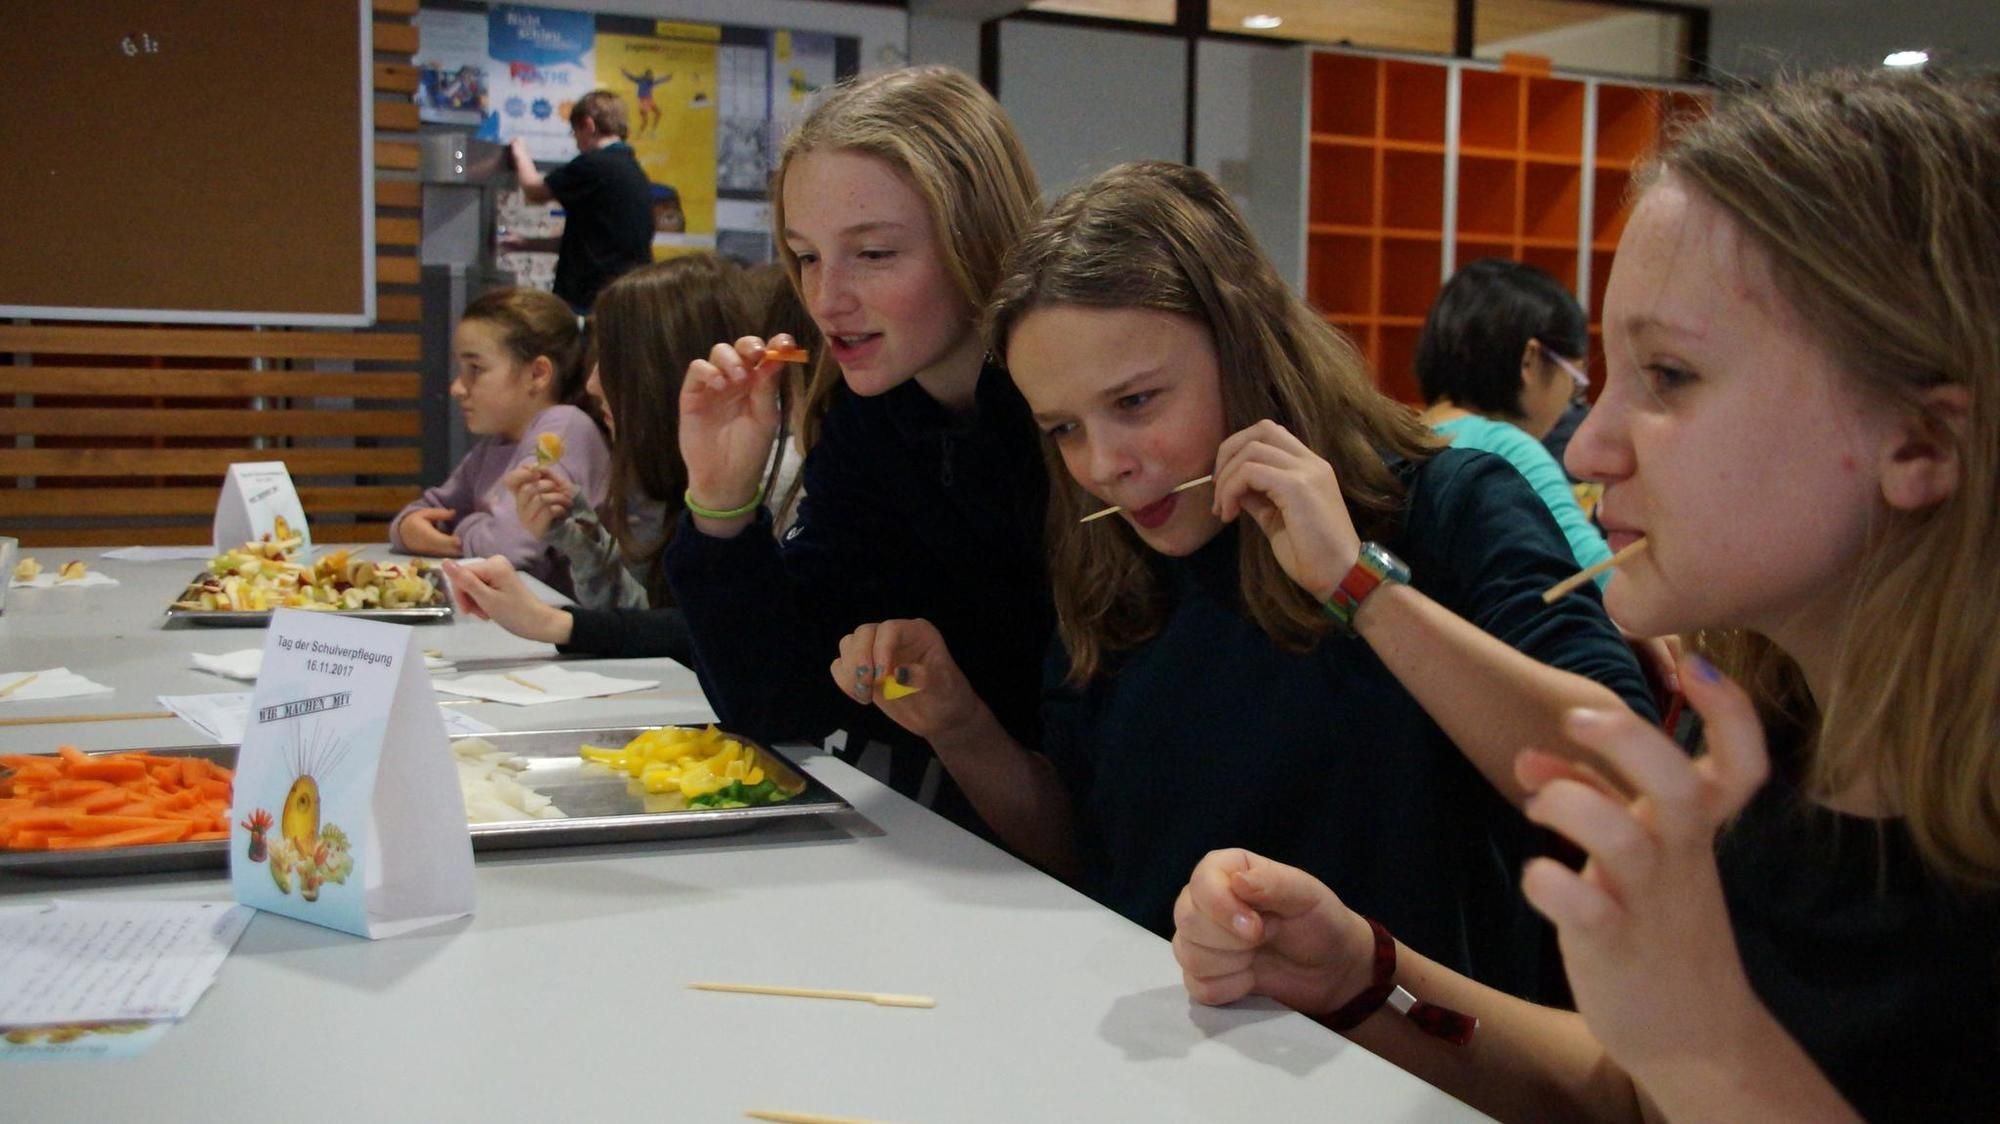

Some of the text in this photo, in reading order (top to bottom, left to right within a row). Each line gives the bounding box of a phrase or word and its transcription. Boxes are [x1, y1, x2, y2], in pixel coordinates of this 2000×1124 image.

[278, 635, 393, 667] Tag der Schulverpflegung
[306, 659, 354, 677] 16.11.2017
[260, 694, 350, 721] WIR MACHEN MIT
